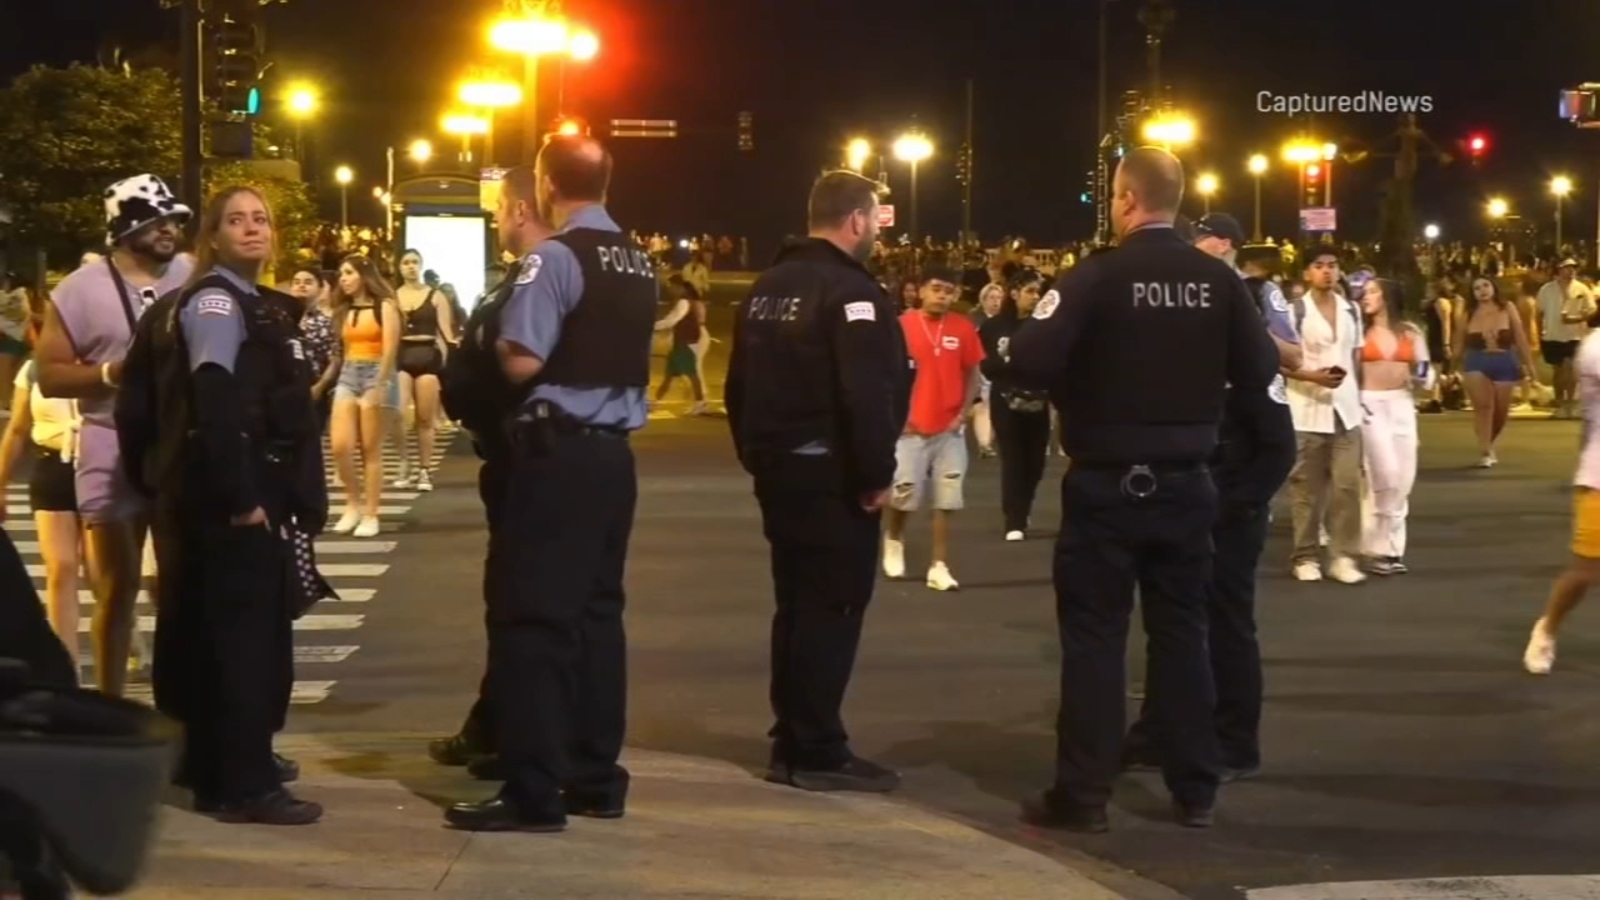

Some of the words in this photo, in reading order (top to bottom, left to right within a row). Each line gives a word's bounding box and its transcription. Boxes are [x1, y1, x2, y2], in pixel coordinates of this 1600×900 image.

[597, 246, 654, 278] POLICE
[1133, 282, 1211, 307] POLICE
[748, 296, 801, 320] POLICE
